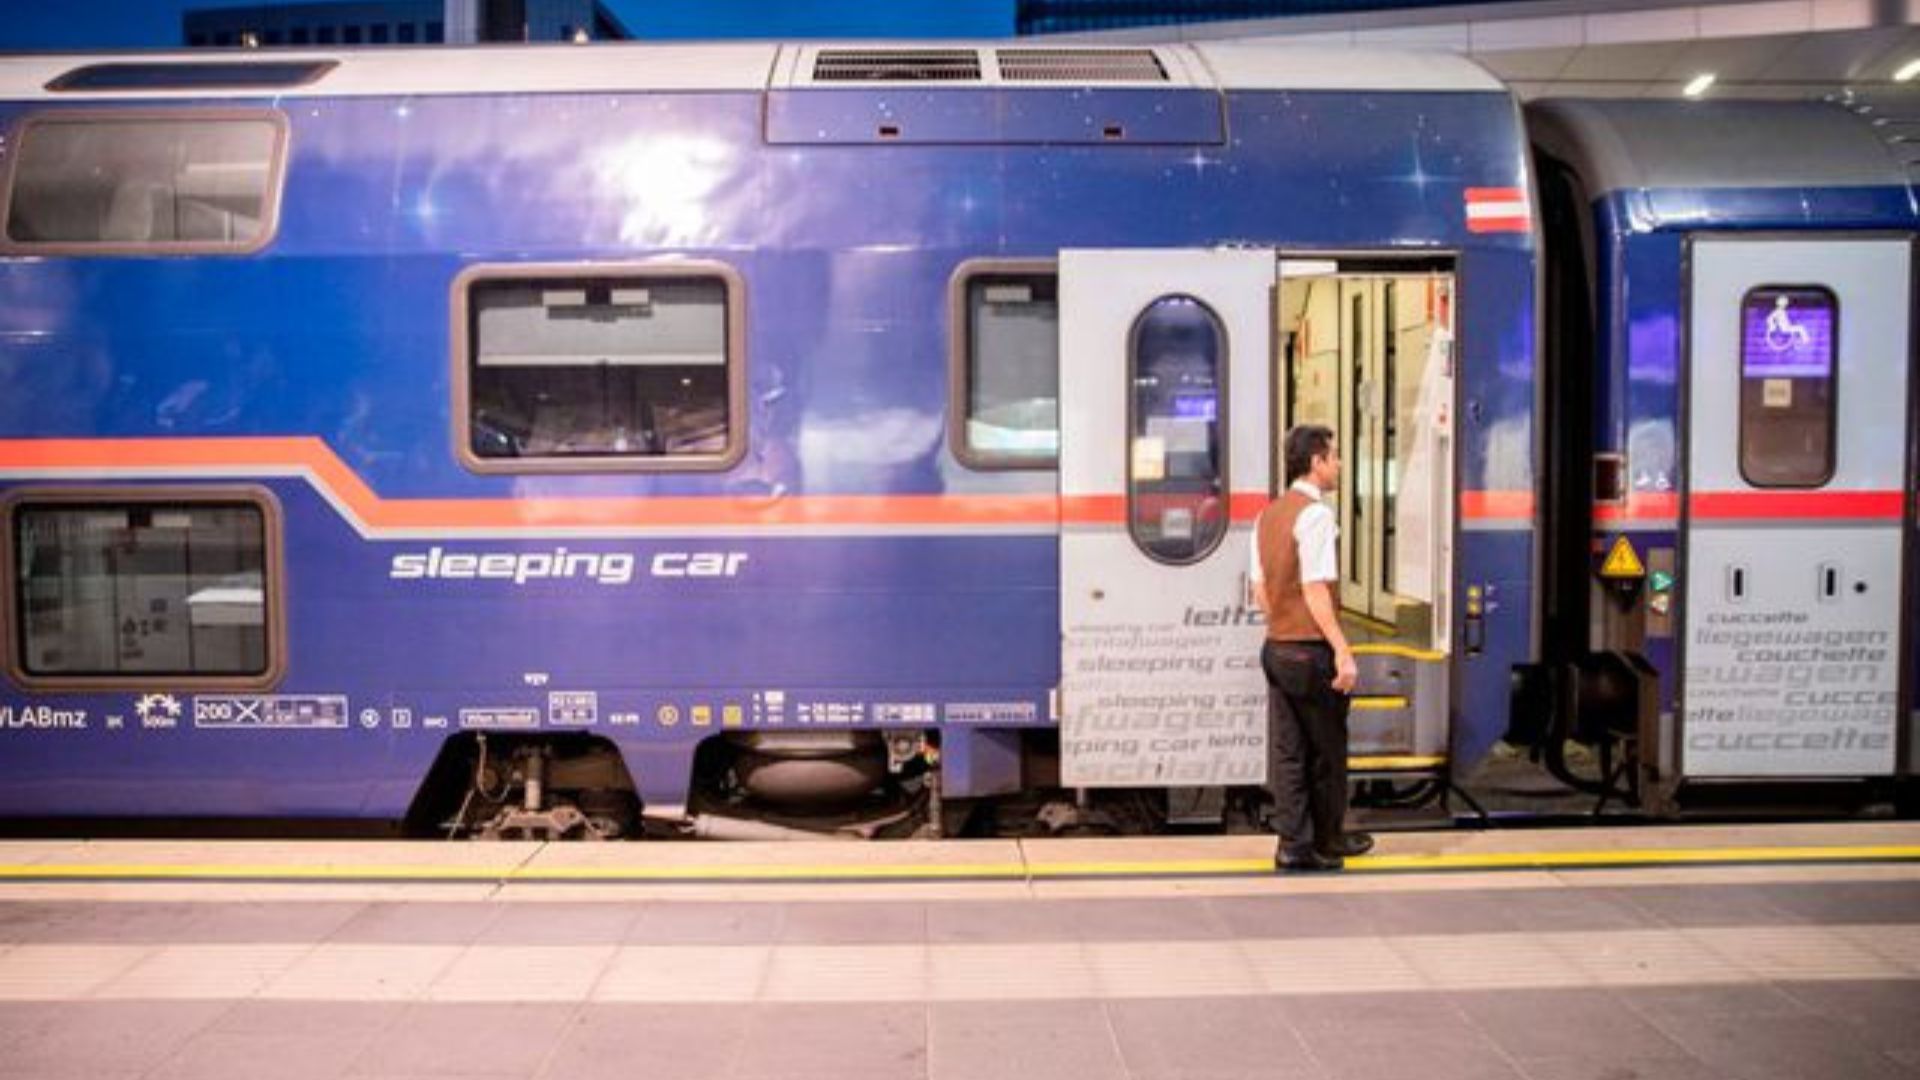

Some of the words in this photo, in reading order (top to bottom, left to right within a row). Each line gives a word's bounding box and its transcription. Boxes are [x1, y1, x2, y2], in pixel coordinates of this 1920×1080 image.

[390, 547, 634, 584] sleeping
[651, 552, 748, 577] car
[1695, 629, 1887, 649] liegewagen
[1736, 647, 1887, 662] couchette
[1079, 654, 1215, 673] sleeping
[1098, 693, 1216, 709] sleeping
[197, 703, 231, 719] 200
[1149, 739, 1202, 752] car
[1689, 728, 1889, 750] cuccette
